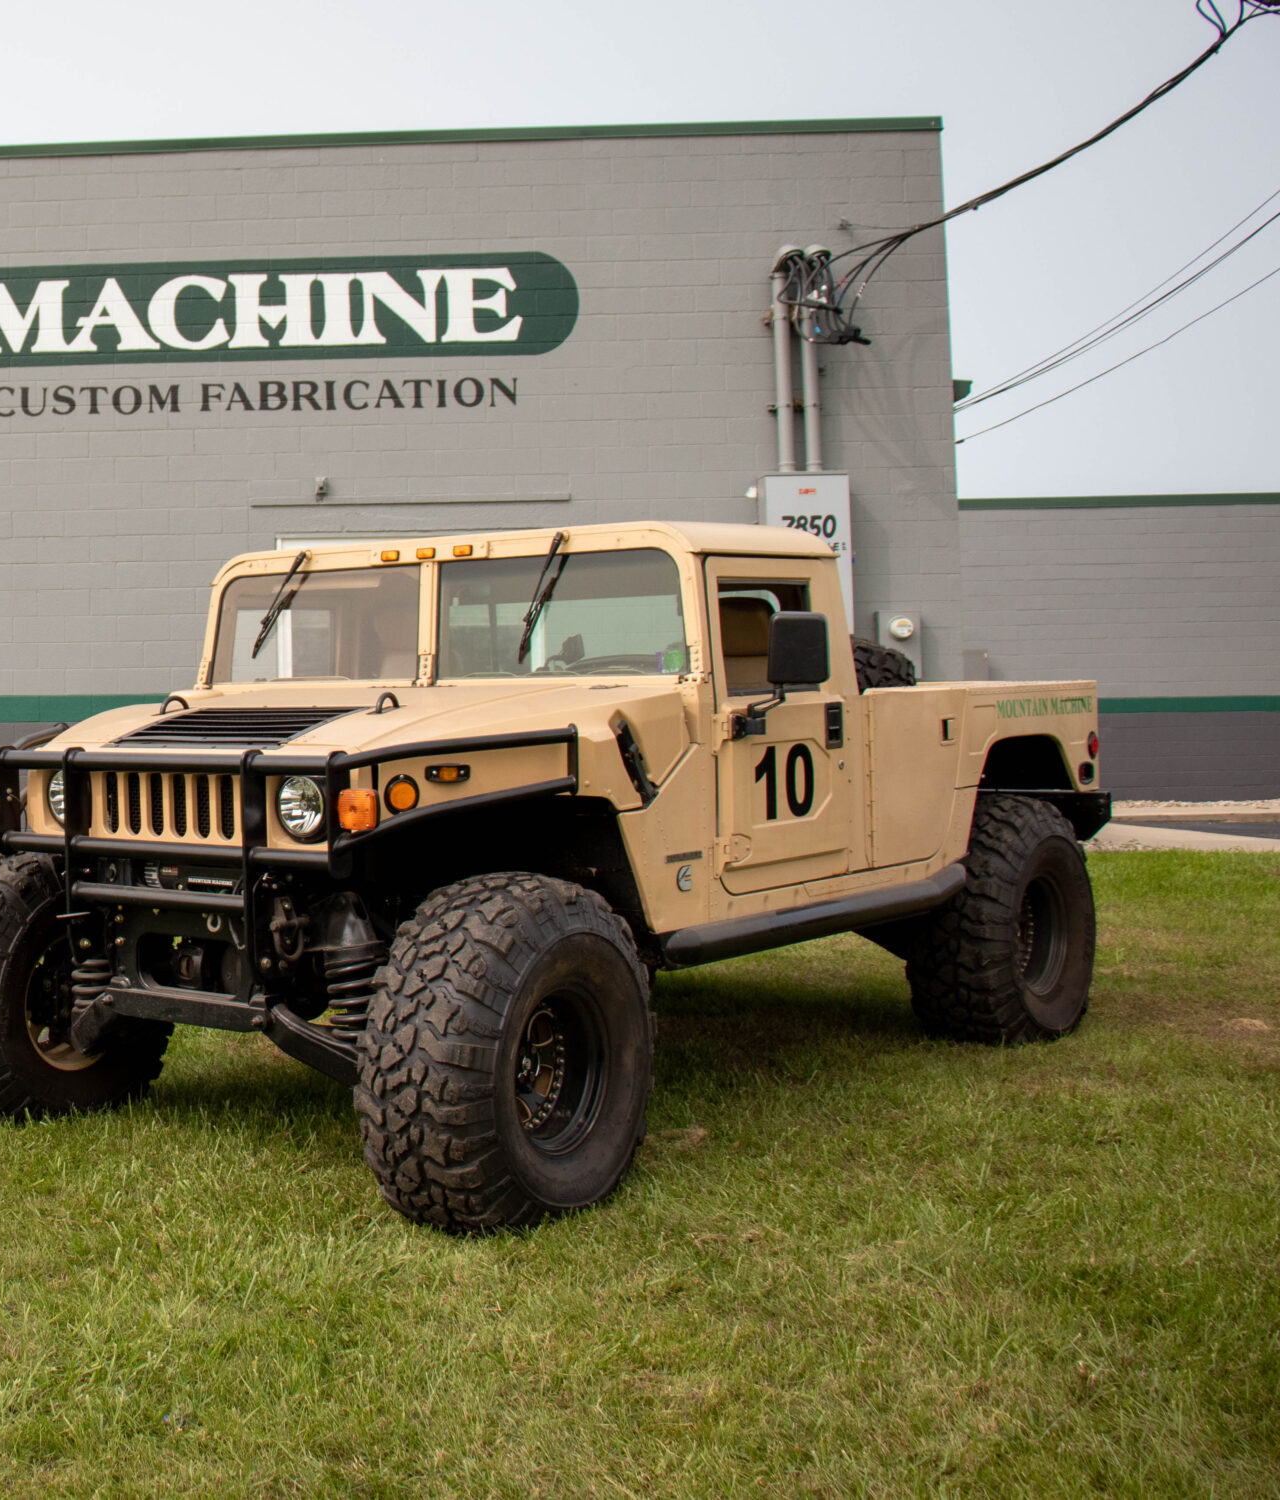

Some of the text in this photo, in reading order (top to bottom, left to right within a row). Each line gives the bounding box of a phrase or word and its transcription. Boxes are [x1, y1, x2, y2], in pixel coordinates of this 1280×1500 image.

[200, 376, 518, 413] FABRICATION
[997, 695, 1093, 719] MOUNTAIN MACHINE
[754, 743, 814, 820] 10
